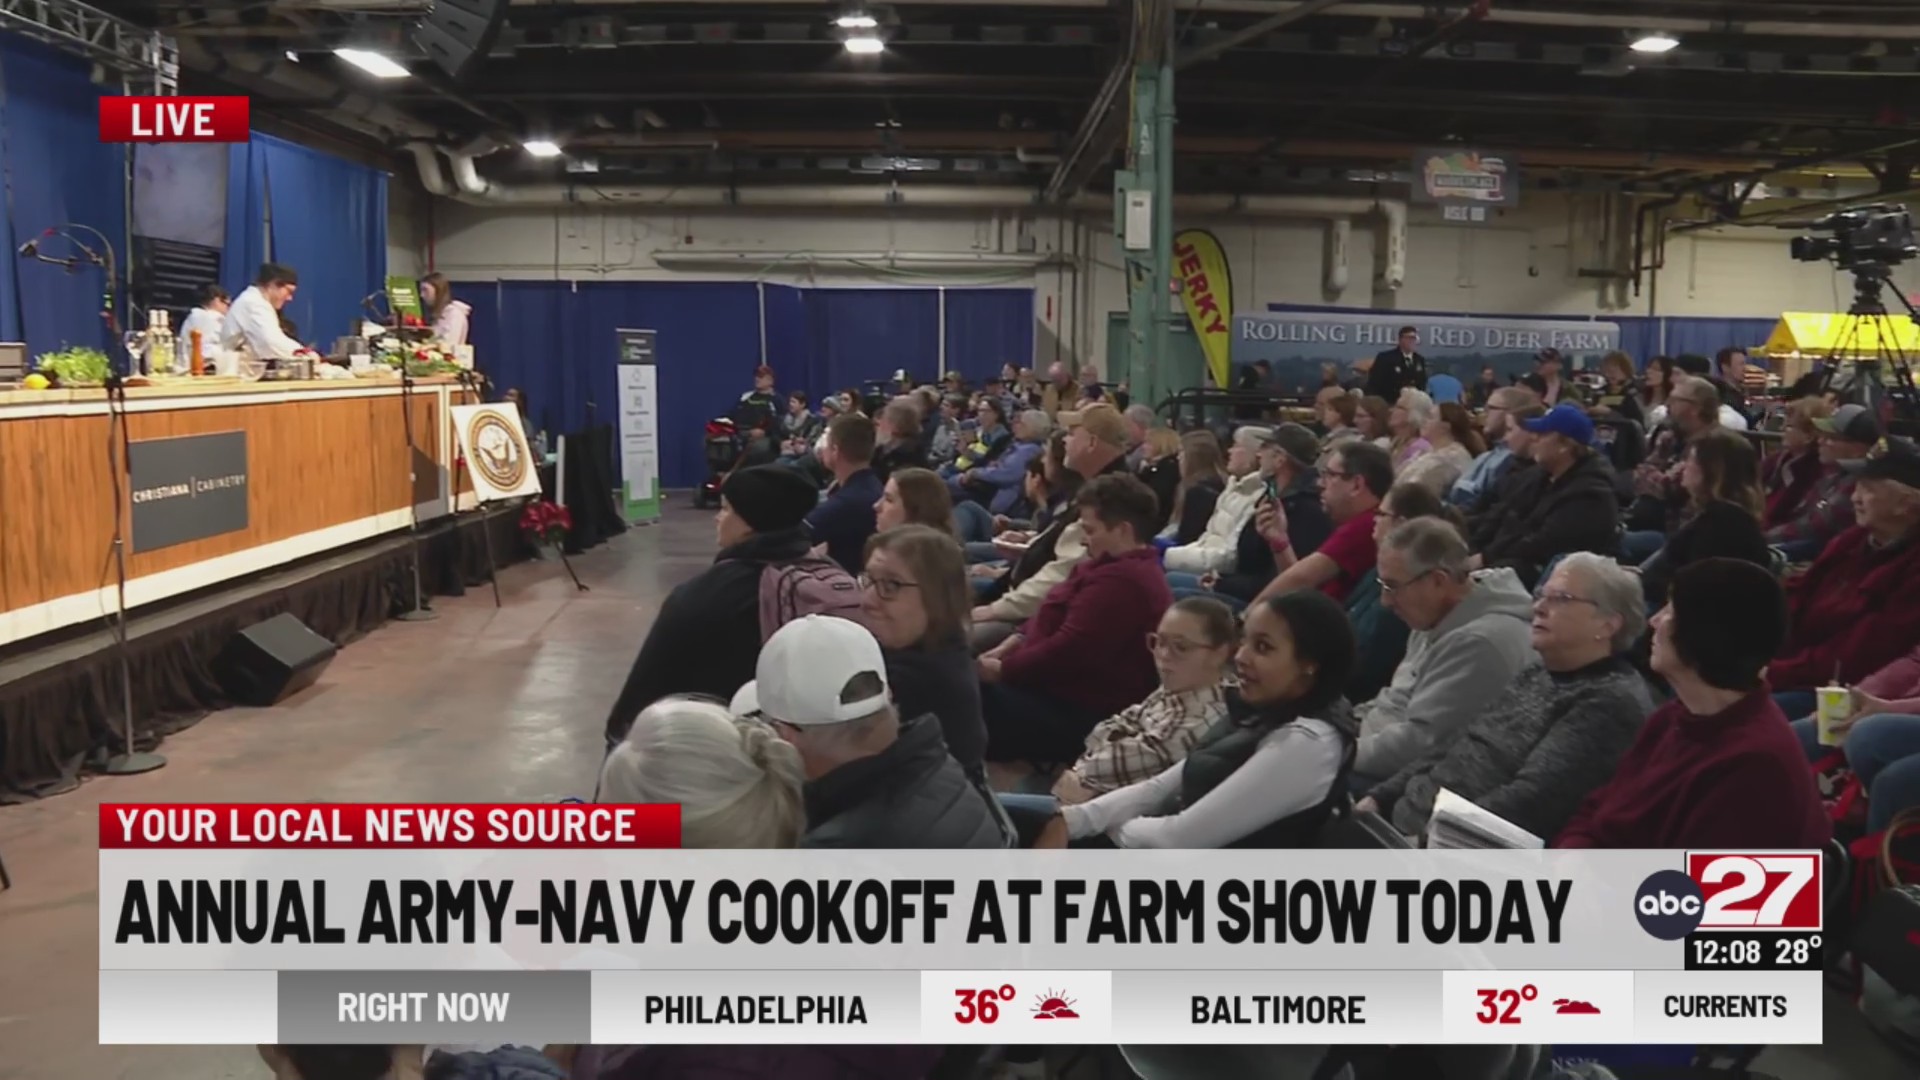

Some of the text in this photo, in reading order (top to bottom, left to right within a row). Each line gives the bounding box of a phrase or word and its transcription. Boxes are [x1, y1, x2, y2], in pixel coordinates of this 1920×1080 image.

[1173, 241, 1229, 334] JERKY
[1242, 319, 1346, 344] ROLLING
[1429, 326, 1476, 346] RED
[1484, 328, 1542, 348] DEER
[1550, 330, 1609, 350] FARM
